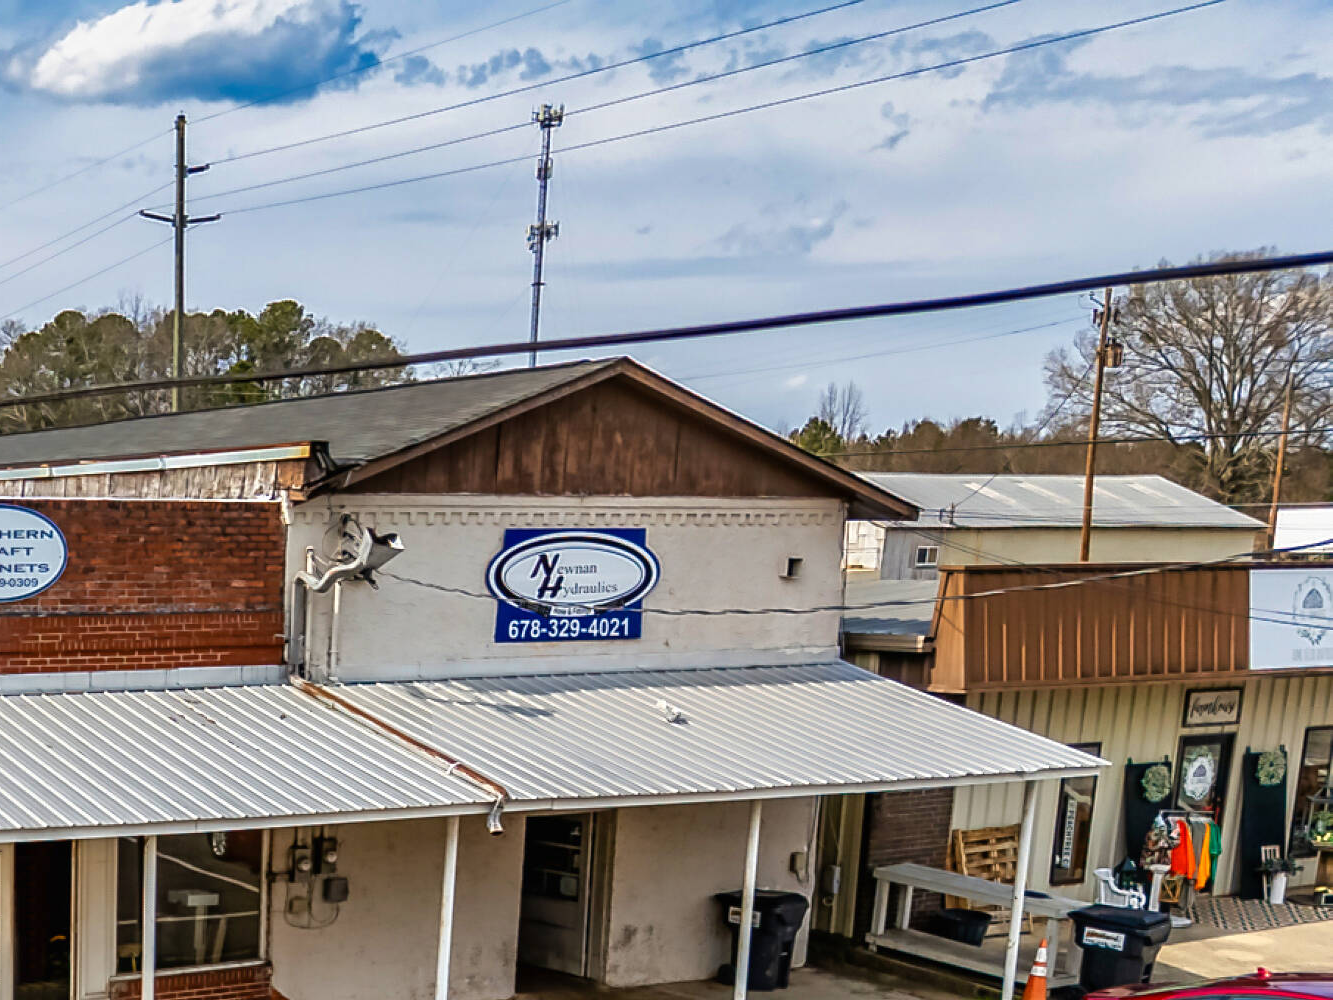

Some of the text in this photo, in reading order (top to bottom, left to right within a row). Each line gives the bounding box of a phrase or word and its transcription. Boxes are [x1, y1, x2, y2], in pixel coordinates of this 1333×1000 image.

[530, 553, 598, 579] Newnan
[537, 575, 619, 599] Hydraulics
[508, 617, 630, 639] 678-329-4021
